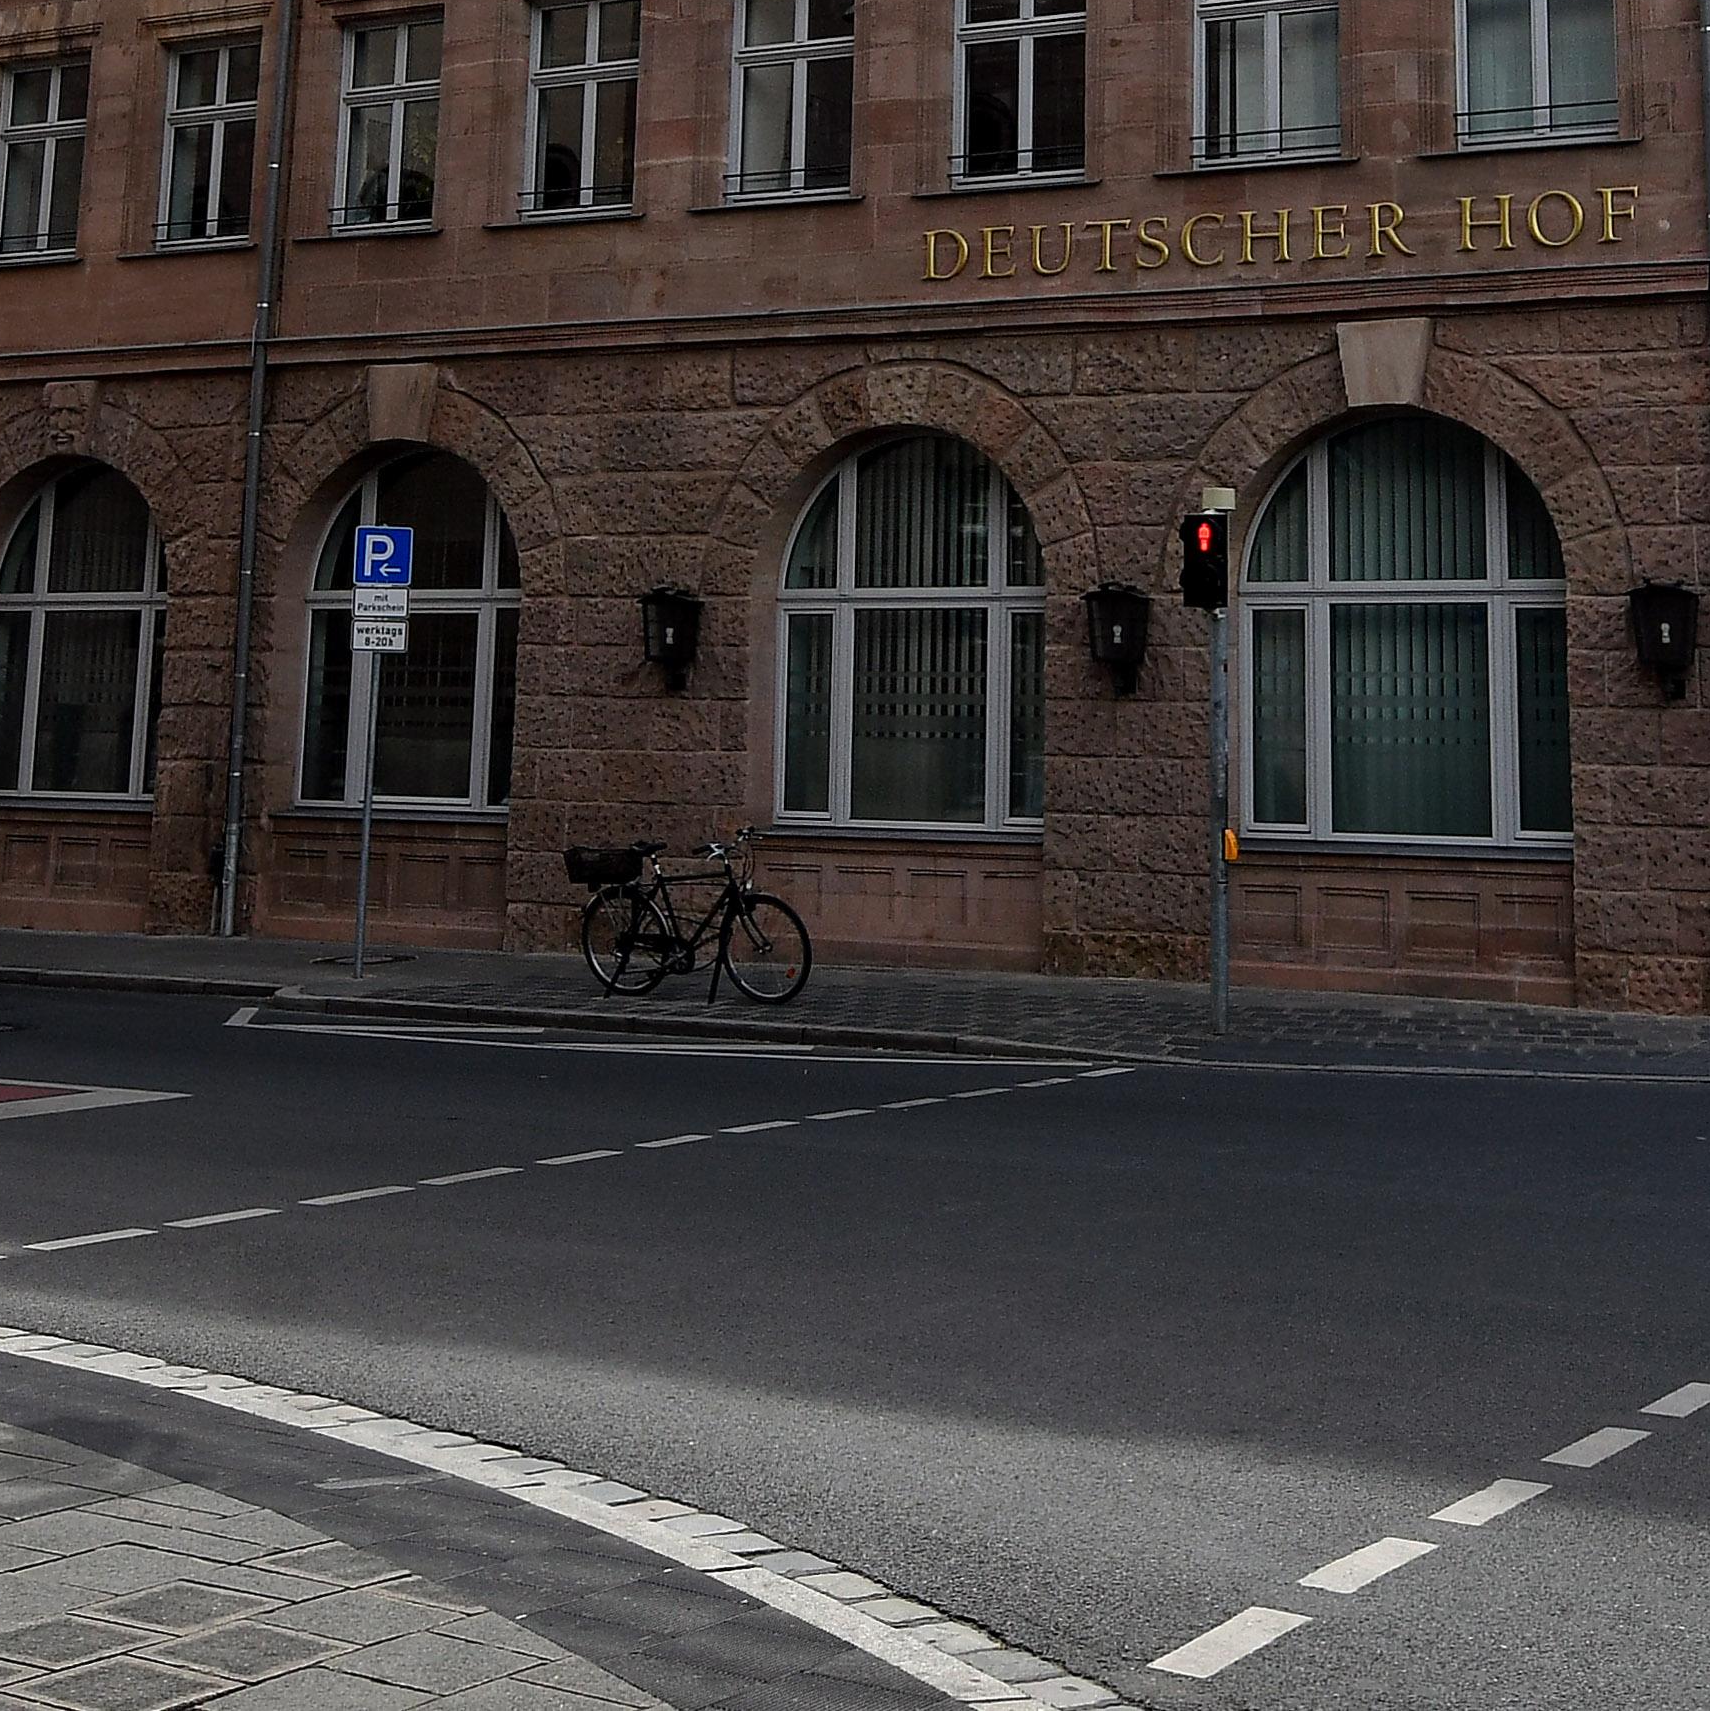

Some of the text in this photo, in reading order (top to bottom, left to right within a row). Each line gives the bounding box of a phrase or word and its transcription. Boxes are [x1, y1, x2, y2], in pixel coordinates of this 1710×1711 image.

[921, 186, 1640, 281] DEUTSCHER HOF
[364, 534, 395, 577] P
[373, 593, 389, 602] mit
[357, 602, 404, 611] Parkschein
[356, 624, 403, 636] werktags
[364, 637, 394, 647] 8-20h
